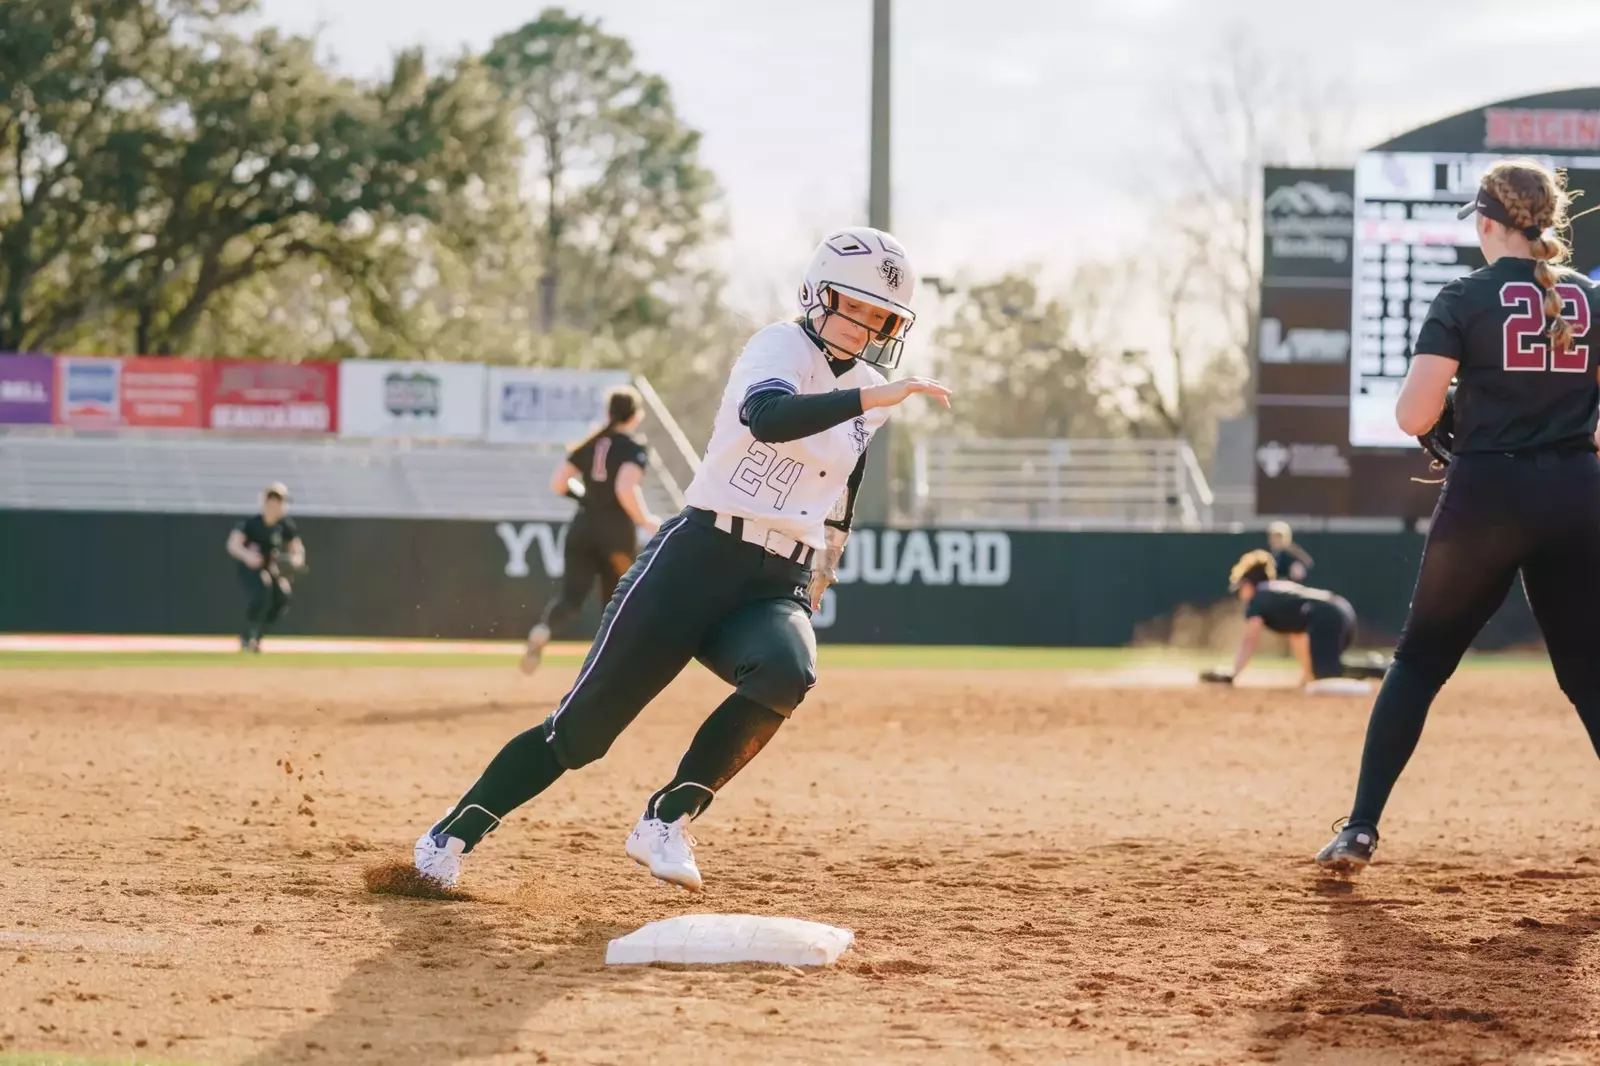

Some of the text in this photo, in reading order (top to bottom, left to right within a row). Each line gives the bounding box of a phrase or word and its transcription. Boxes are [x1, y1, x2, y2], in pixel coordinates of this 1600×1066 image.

[881, 258, 900, 288] SFA
[1499, 282, 1590, 372] 22
[729, 439, 804, 510] 24
